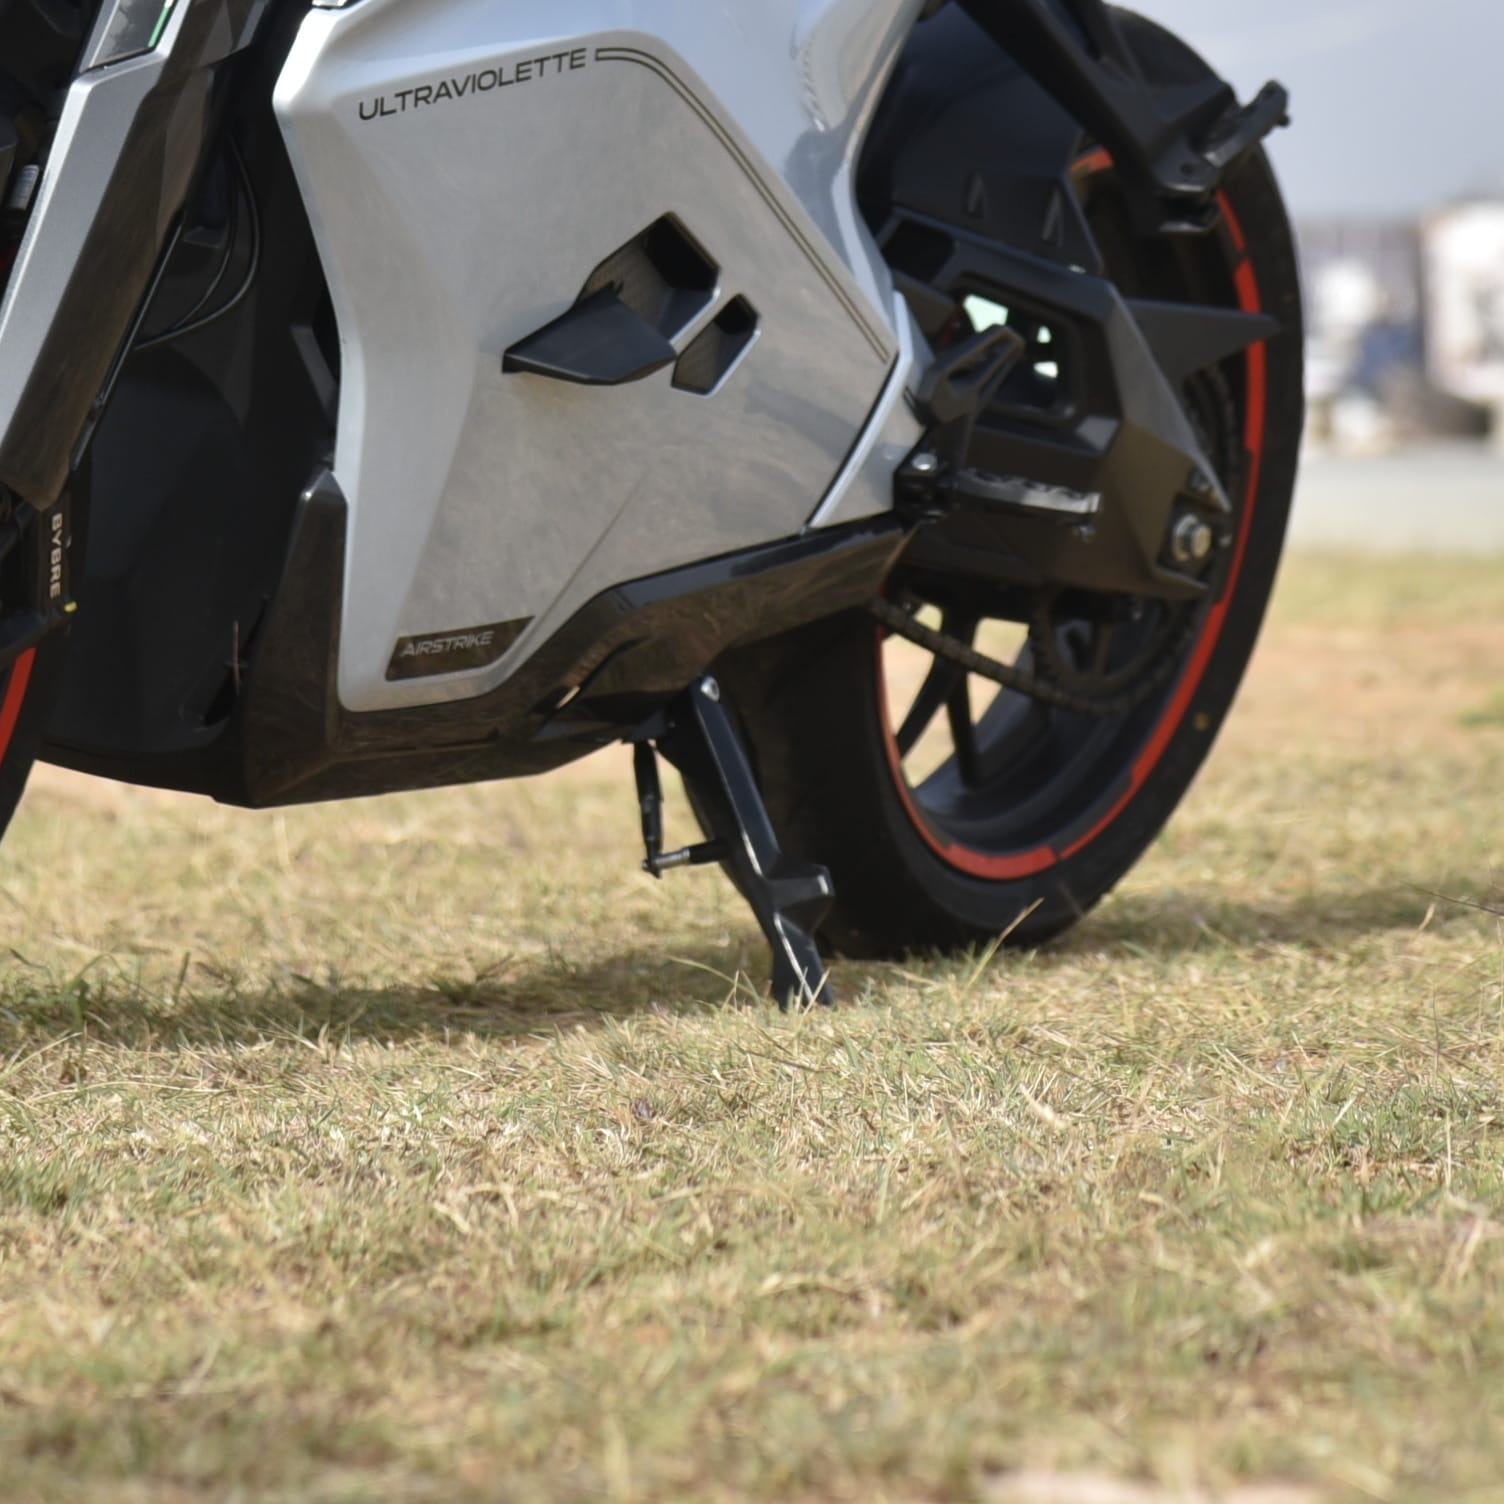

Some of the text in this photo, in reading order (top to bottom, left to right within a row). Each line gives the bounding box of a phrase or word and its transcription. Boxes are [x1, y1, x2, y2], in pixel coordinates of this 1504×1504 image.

[359, 48, 586, 121] ULTRAVIOLETTE
[50, 512, 63, 599] BYBRE
[401, 630, 494, 657] AIRSTRIKE
